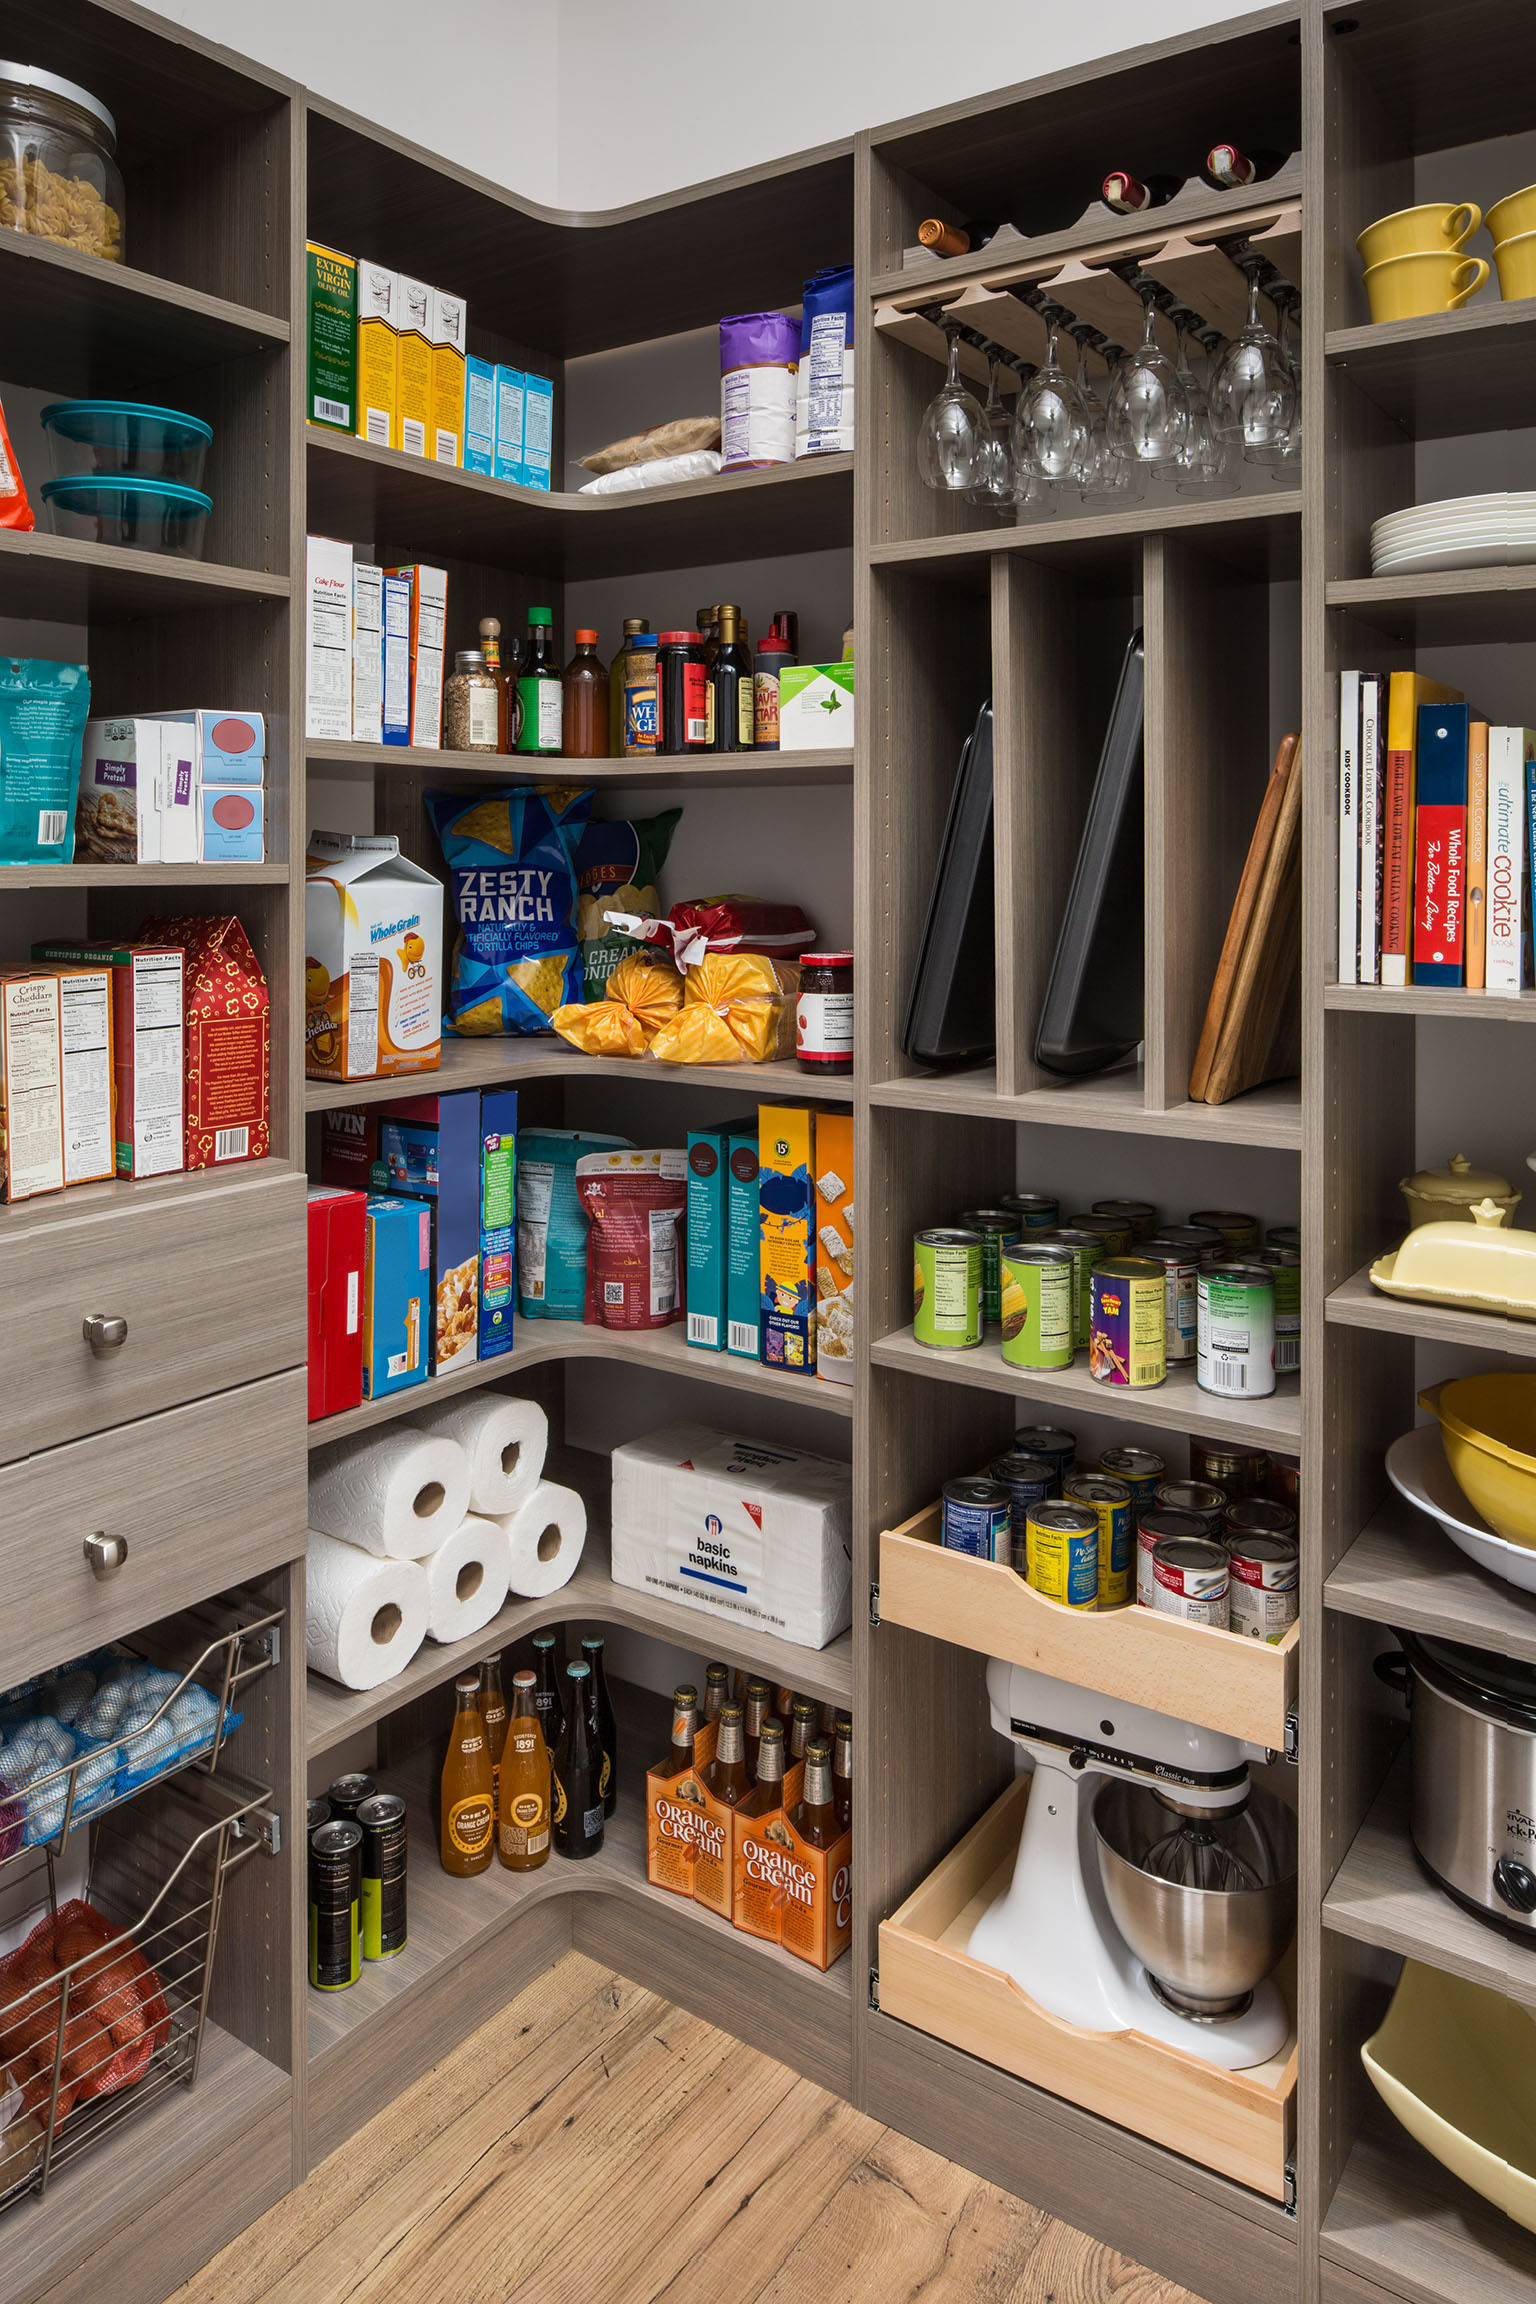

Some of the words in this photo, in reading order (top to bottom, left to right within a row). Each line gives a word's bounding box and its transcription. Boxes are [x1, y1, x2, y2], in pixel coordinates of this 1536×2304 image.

[316, 257, 349, 278] EXTRA
[316, 269, 351, 290] VIRGIN
[317, 281, 337, 294] OLIVE
[337, 289, 350, 299] OIL
[314, 576, 329, 587] Cake
[329, 579, 345, 589] Flour
[313, 589, 333, 597] Nutrition
[334, 592, 346, 600] Facts
[755, 690, 778, 706] AVE
[104, 762, 126, 774] Simply
[103, 772, 126, 783] Pretzel
[176, 770, 185, 794] Simply
[1364, 801, 1375, 846] COOKBOOK
[1498, 787, 1514, 853] ultimate
[1474, 807, 1485, 863] COOKBOOK
[1427, 840, 1441, 860] For
[1448, 829, 1462, 866] Whole
[459, 870, 553, 897] ZESTY
[1390, 864, 1401, 903] ITALIAN
[1427, 861, 1440, 894] Better
[1447, 869, 1461, 897] Food
[1492, 855, 1518, 938] cookie
[460, 898, 554, 923] RANCH
[1421, 895, 1440, 932] Living
[370, 922, 397, 943] Whole
[396, 914, 420, 934] Grain
[477, 922, 527, 932] NATURALLY
[1388, 906, 1400, 949] COOKING
[1442, 901, 1460, 943] Recipes
[466, 932, 513, 943] TIFICIALLY
[514, 931, 559, 941] FLAVORED
[1490, 937, 1515, 948] book
[472, 941, 513, 952] TORTILLA
[515, 941, 540, 950] CHIPS
[45, 950, 82, 959] CERTIFIED
[84, 952, 114, 961] ORGANIC
[19, 984, 46, 996] Crispy
[12, 992, 53, 1005] Cheddars
[10, 1009, 35, 1017] Nutrition
[326, 1111, 366, 1136] WIN
[1103, 1307, 1119, 1316] YAM
[749, 1504, 761, 1514] 500
[1035, 1530, 1050, 1539] Nutrition
[696, 1537, 731, 1559] basic
[688, 1552, 738, 1576] napkins
[535, 1697, 552, 1707] 891
[486, 1710, 505, 1720] DIET
[461, 1739, 483, 1748] DIET
[516, 1740, 534, 1749] 1891
[1154, 1765, 1182, 1782] Classic
[1182, 1777, 1195, 1785] Plus
[460, 1808, 487, 1820] DIET
[456, 1821, 476, 1830] ORANGE
[656, 1836, 683, 1850] Gourmet
[743, 1877, 771, 1893] Gourmet
